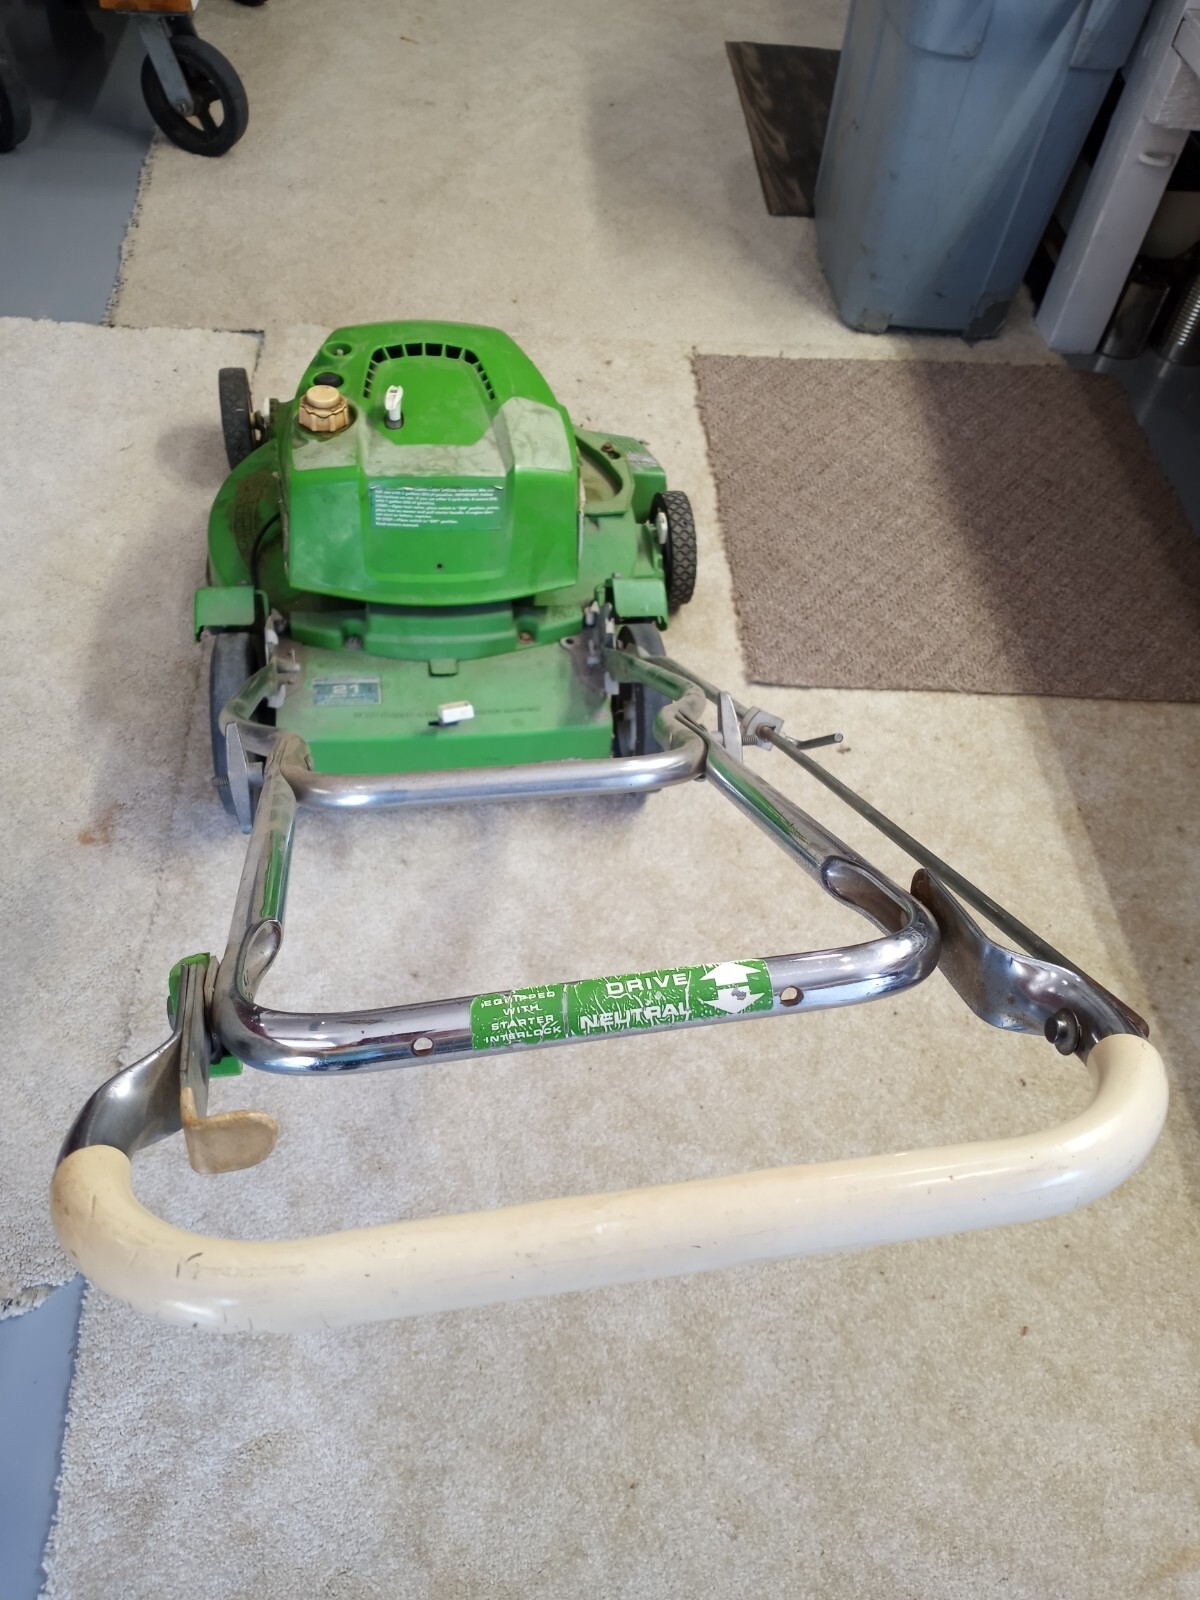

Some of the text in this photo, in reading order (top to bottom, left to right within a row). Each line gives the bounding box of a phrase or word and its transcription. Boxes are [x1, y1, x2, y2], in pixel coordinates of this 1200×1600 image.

[606, 973, 688, 995] DRIVE
[503, 1004, 541, 1016] WITH
[580, 1002, 690, 1029] NEUTRAL
[491, 1015, 554, 1031] STARTER
[485, 1026, 562, 1043] INTERLOCK
